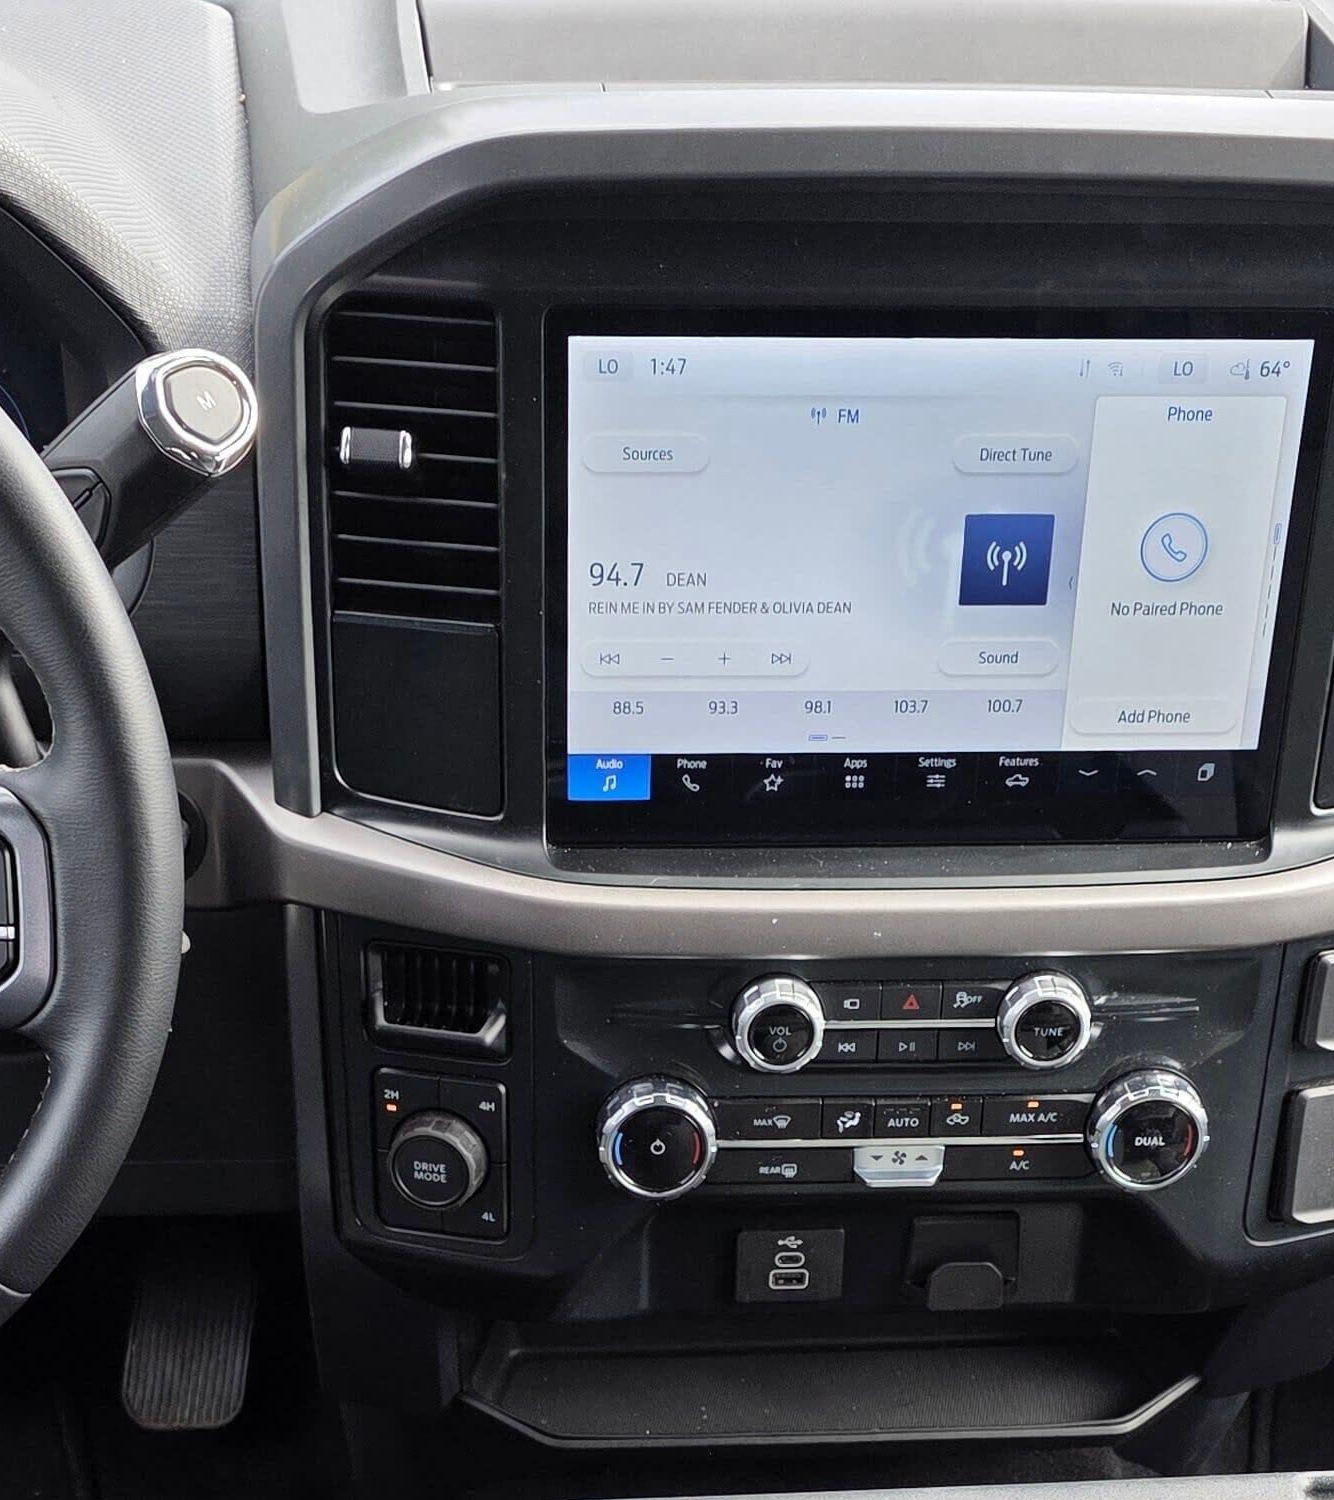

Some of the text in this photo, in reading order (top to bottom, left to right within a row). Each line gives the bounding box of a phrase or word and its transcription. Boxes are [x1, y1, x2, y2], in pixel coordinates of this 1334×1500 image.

[598, 360, 619, 375] LO
[650, 358, 686, 376] 1:47
[1173, 362, 1194, 377] LO
[197, 391, 217, 411] M
[838, 409, 860, 424] FM
[1167, 406, 1213, 424] Phone
[622, 446, 673, 462] Sources
[979, 447, 1052, 463] Direct Tune
[589, 562, 707, 588] 94.7 DEAN
[589, 601, 852, 614] REIN ME IN BY SAM FENDER & OLIVIA DEAN
[1110, 601, 1223, 617] No Paired Phone
[978, 651, 1018, 666] Sound
[612, 700, 644, 715] 88.5
[708, 700, 738, 715] 93.3
[805, 700, 833, 714] 98.1
[894, 700, 928, 714] 103.7
[986, 698, 1022, 713] 100.7
[1118, 709, 1190, 724] Add Phone
[596, 759, 623, 769] Audio
[677, 759, 707, 769] Phone
[766, 759, 783, 769] Fav
[844, 758, 868, 771] Apps
[918, 757, 956, 769] Settings
[999, 756, 1039, 767] Features
[769, 1026, 792, 1036] VOL
[1034, 1027, 1064, 1036] TUNE
[384, 1089, 399, 1100] 2H
[479, 1101, 495, 1111] 4H
[753, 1118, 772, 1126] MAX
[888, 1117, 919, 1127] AUTO
[1010, 1112, 1057, 1123] MAX A/C
[1135, 1137, 1165, 1146] DUAL
[414, 1161, 446, 1173] DRIVE
[759, 1166, 780, 1174] REAR
[1010, 1160, 1029, 1170] A/C
[414, 1171, 447, 1183] MODE
[482, 1212, 495, 1222] 4L
